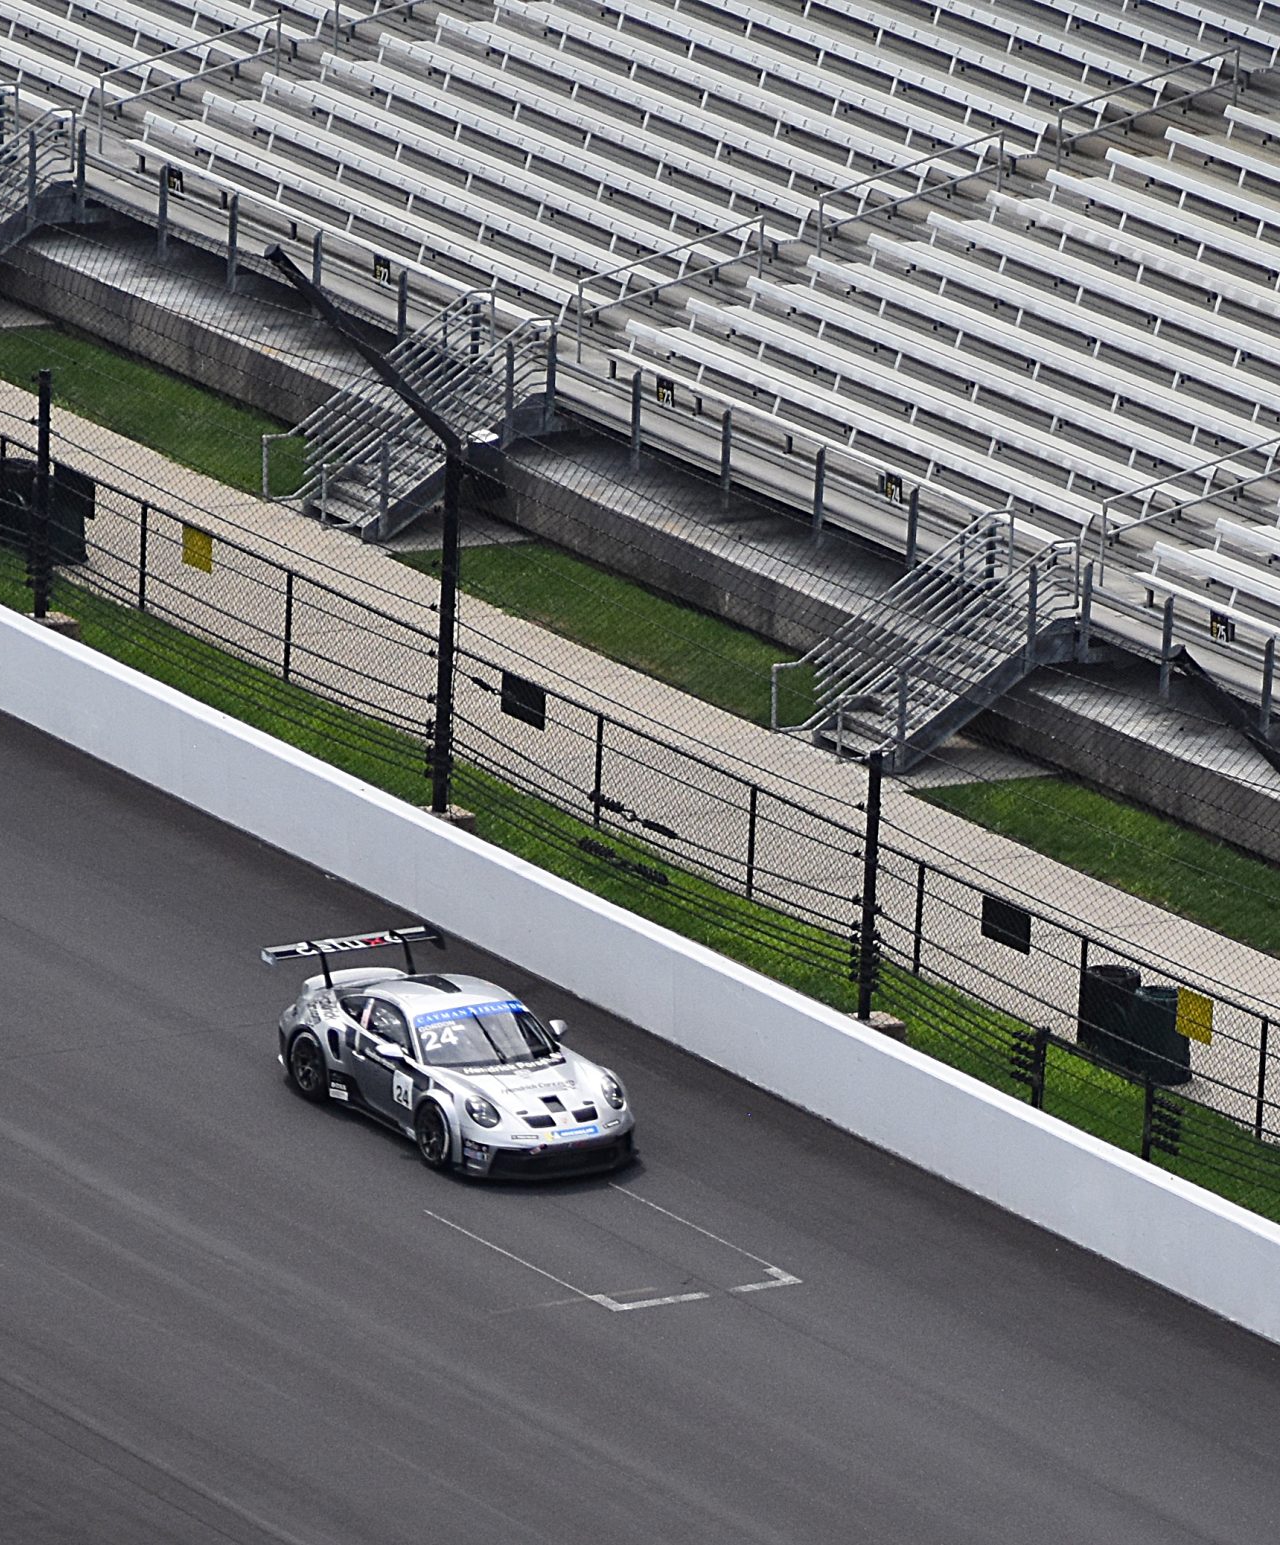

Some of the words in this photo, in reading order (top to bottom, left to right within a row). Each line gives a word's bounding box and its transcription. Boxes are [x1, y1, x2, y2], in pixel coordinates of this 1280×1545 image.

[417, 1009, 467, 1023] CAYMAN
[477, 1003, 523, 1013] ISLANDS
[421, 1027, 458, 1051] 24
[396, 1085, 409, 1106] 24
